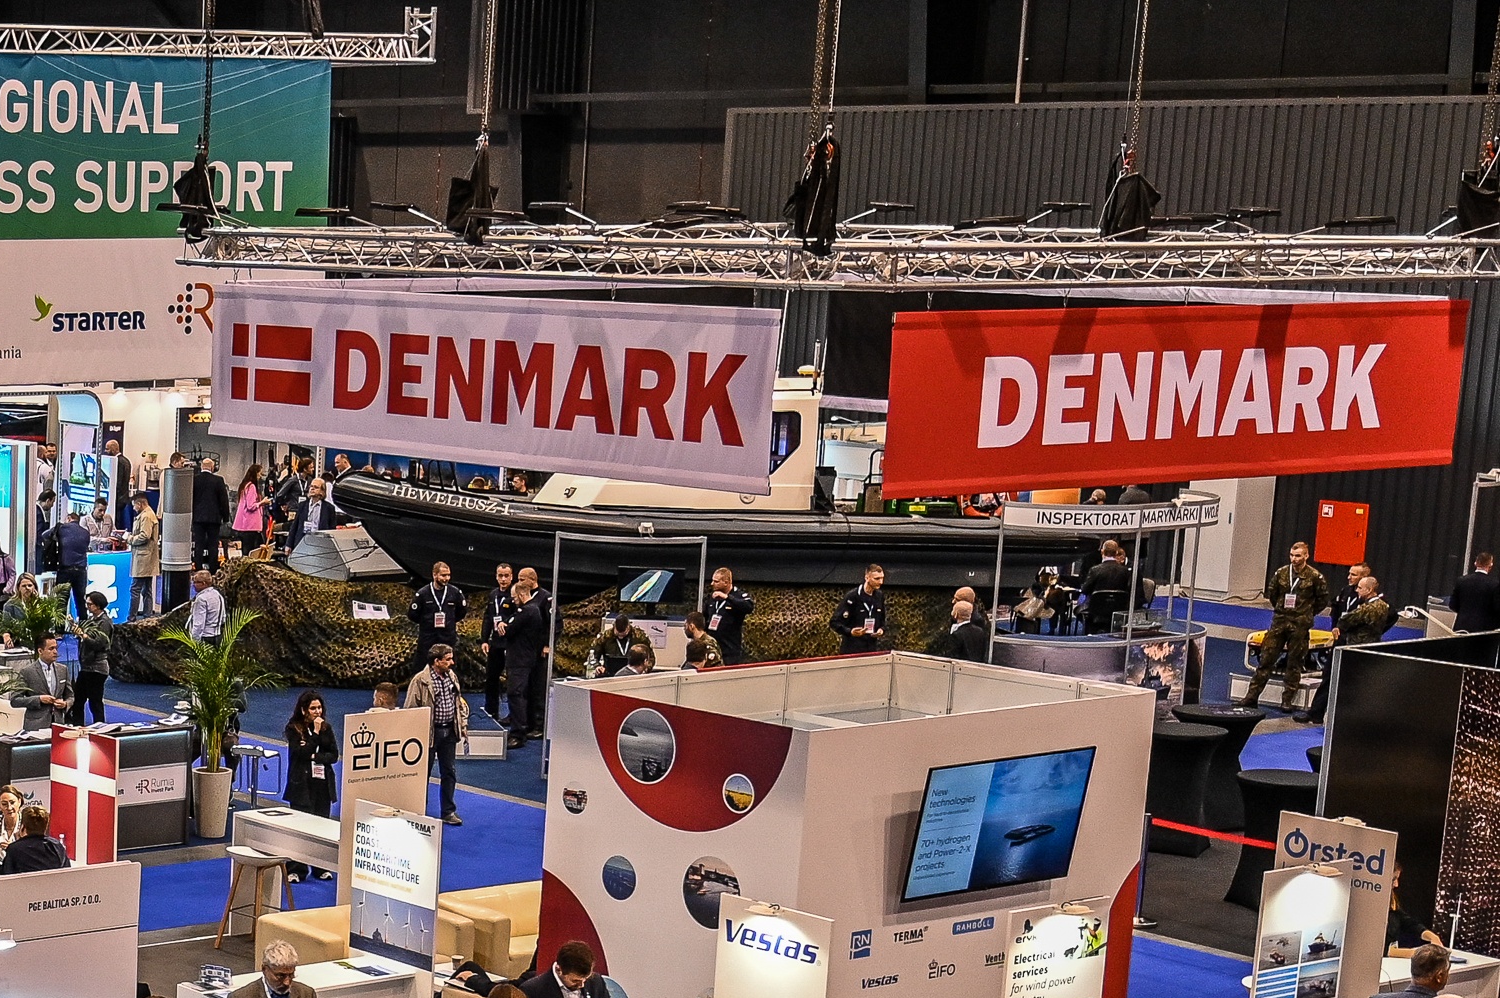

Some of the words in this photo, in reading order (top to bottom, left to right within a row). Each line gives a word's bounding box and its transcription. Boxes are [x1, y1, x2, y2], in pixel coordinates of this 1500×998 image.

[331, 327, 749, 449] DENMARK
[976, 342, 1388, 450] DENMARK
[1036, 511, 1137, 527] INSPEKTORAT
[1141, 506, 1199, 524] MARYNARKI
[352, 737, 424, 771] EIFO
[151, 777, 175, 789] Rumia
[931, 788, 949, 797] New
[929, 794, 976, 809] technologies
[936, 834, 971, 847] hydrogen
[355, 846, 372, 859] AND
[918, 850, 932, 861] and
[354, 858, 421, 885] INFRASTRUCTURE
[915, 861, 945, 873] projects
[28, 901, 42, 913] PGE
[42, 897, 70, 911] BALTICA
[70, 896, 82, 906] SP.
[82, 895, 87, 904] Z
[725, 918, 820, 964] Vestas
[893, 928, 924, 943] TERMA
[1013, 950, 1056, 965] Electrical
[928, 963, 956, 980] EIFO
[1012, 966, 1049, 980] services
[861, 974, 900, 990] Vestas
[1010, 982, 1024, 997] for
[1025, 979, 1047, 992] wind
[1047, 976, 1076, 991] power
